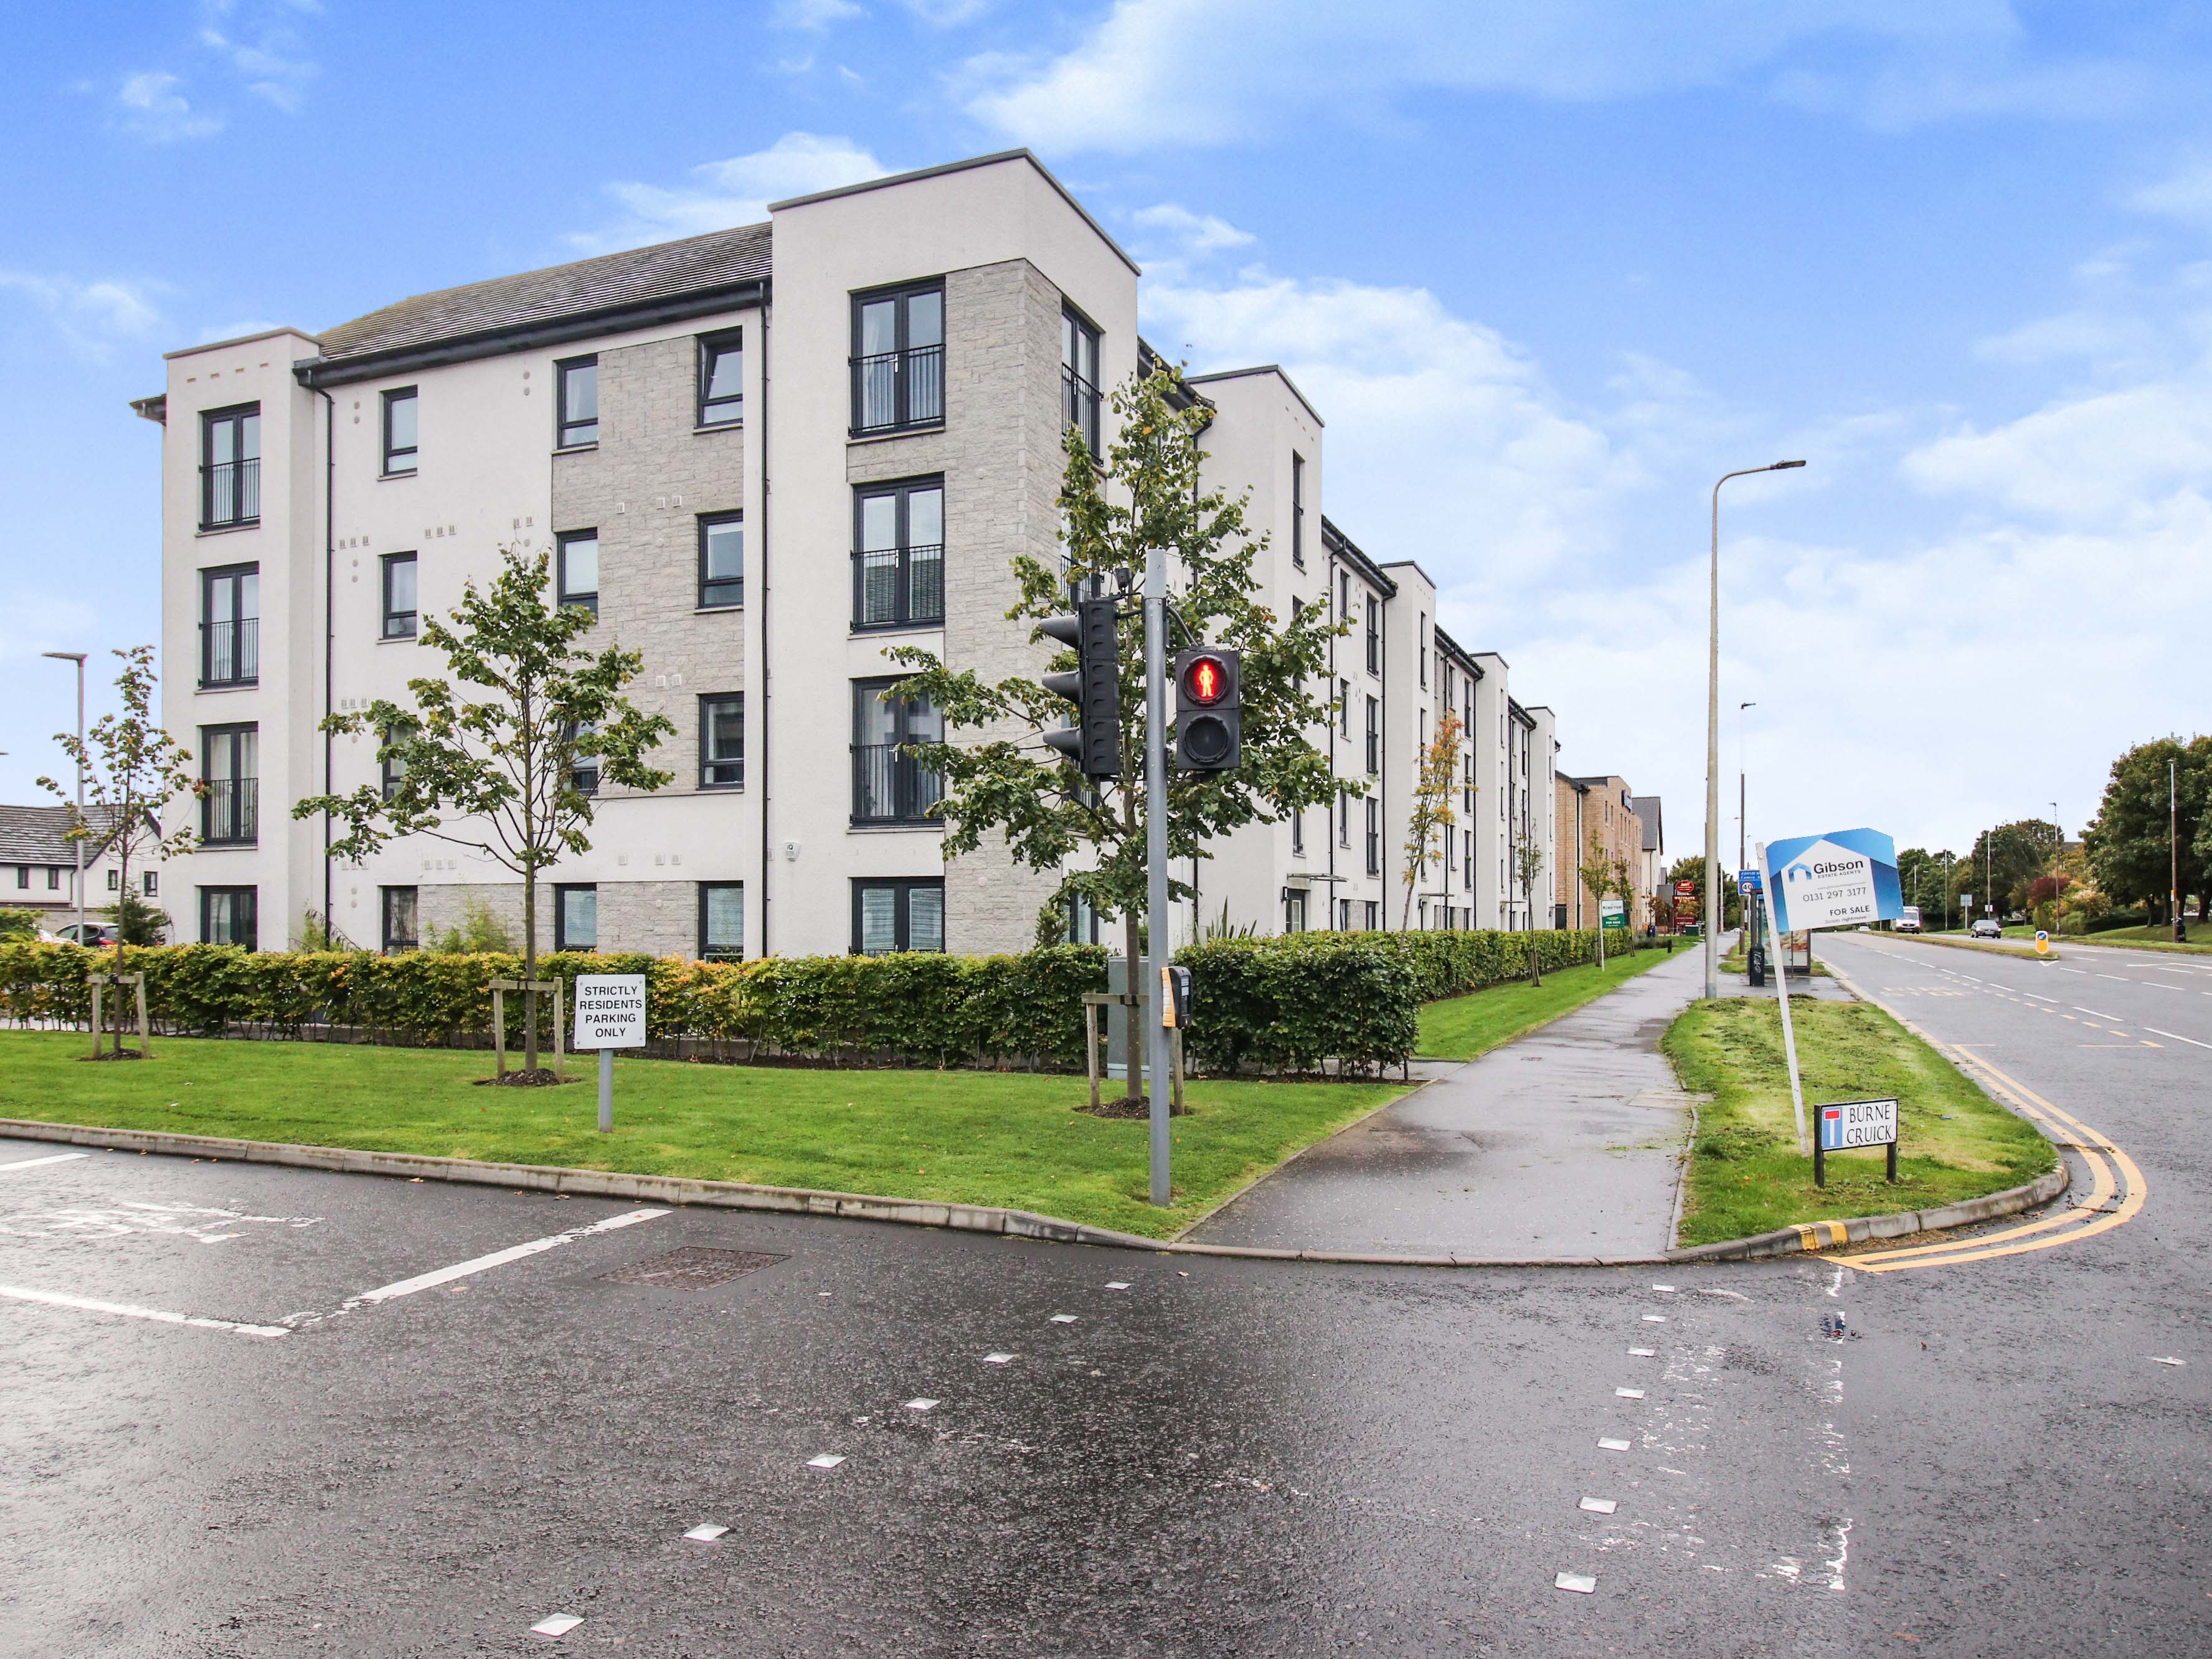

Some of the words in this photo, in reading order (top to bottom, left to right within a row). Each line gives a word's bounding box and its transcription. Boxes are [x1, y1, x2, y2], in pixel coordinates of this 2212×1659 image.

[1813, 860, 1864, 874] Gibson
[1803, 892, 1824, 902] 0131
[1827, 890, 1843, 899] 297
[1846, 887, 1866, 897] 3177
[1830, 908, 1848, 916] FOR
[1850, 905, 1871, 914] SALE
[585, 986, 638, 996] STRICTLY
[580, 1000, 642, 1009] RESIDENTS
[585, 1013, 636, 1024] PARKING
[595, 1028, 626, 1037] ONLY
[1850, 1104, 1891, 1123] BURNE
[1846, 1125, 1892, 1144] CRUICK
